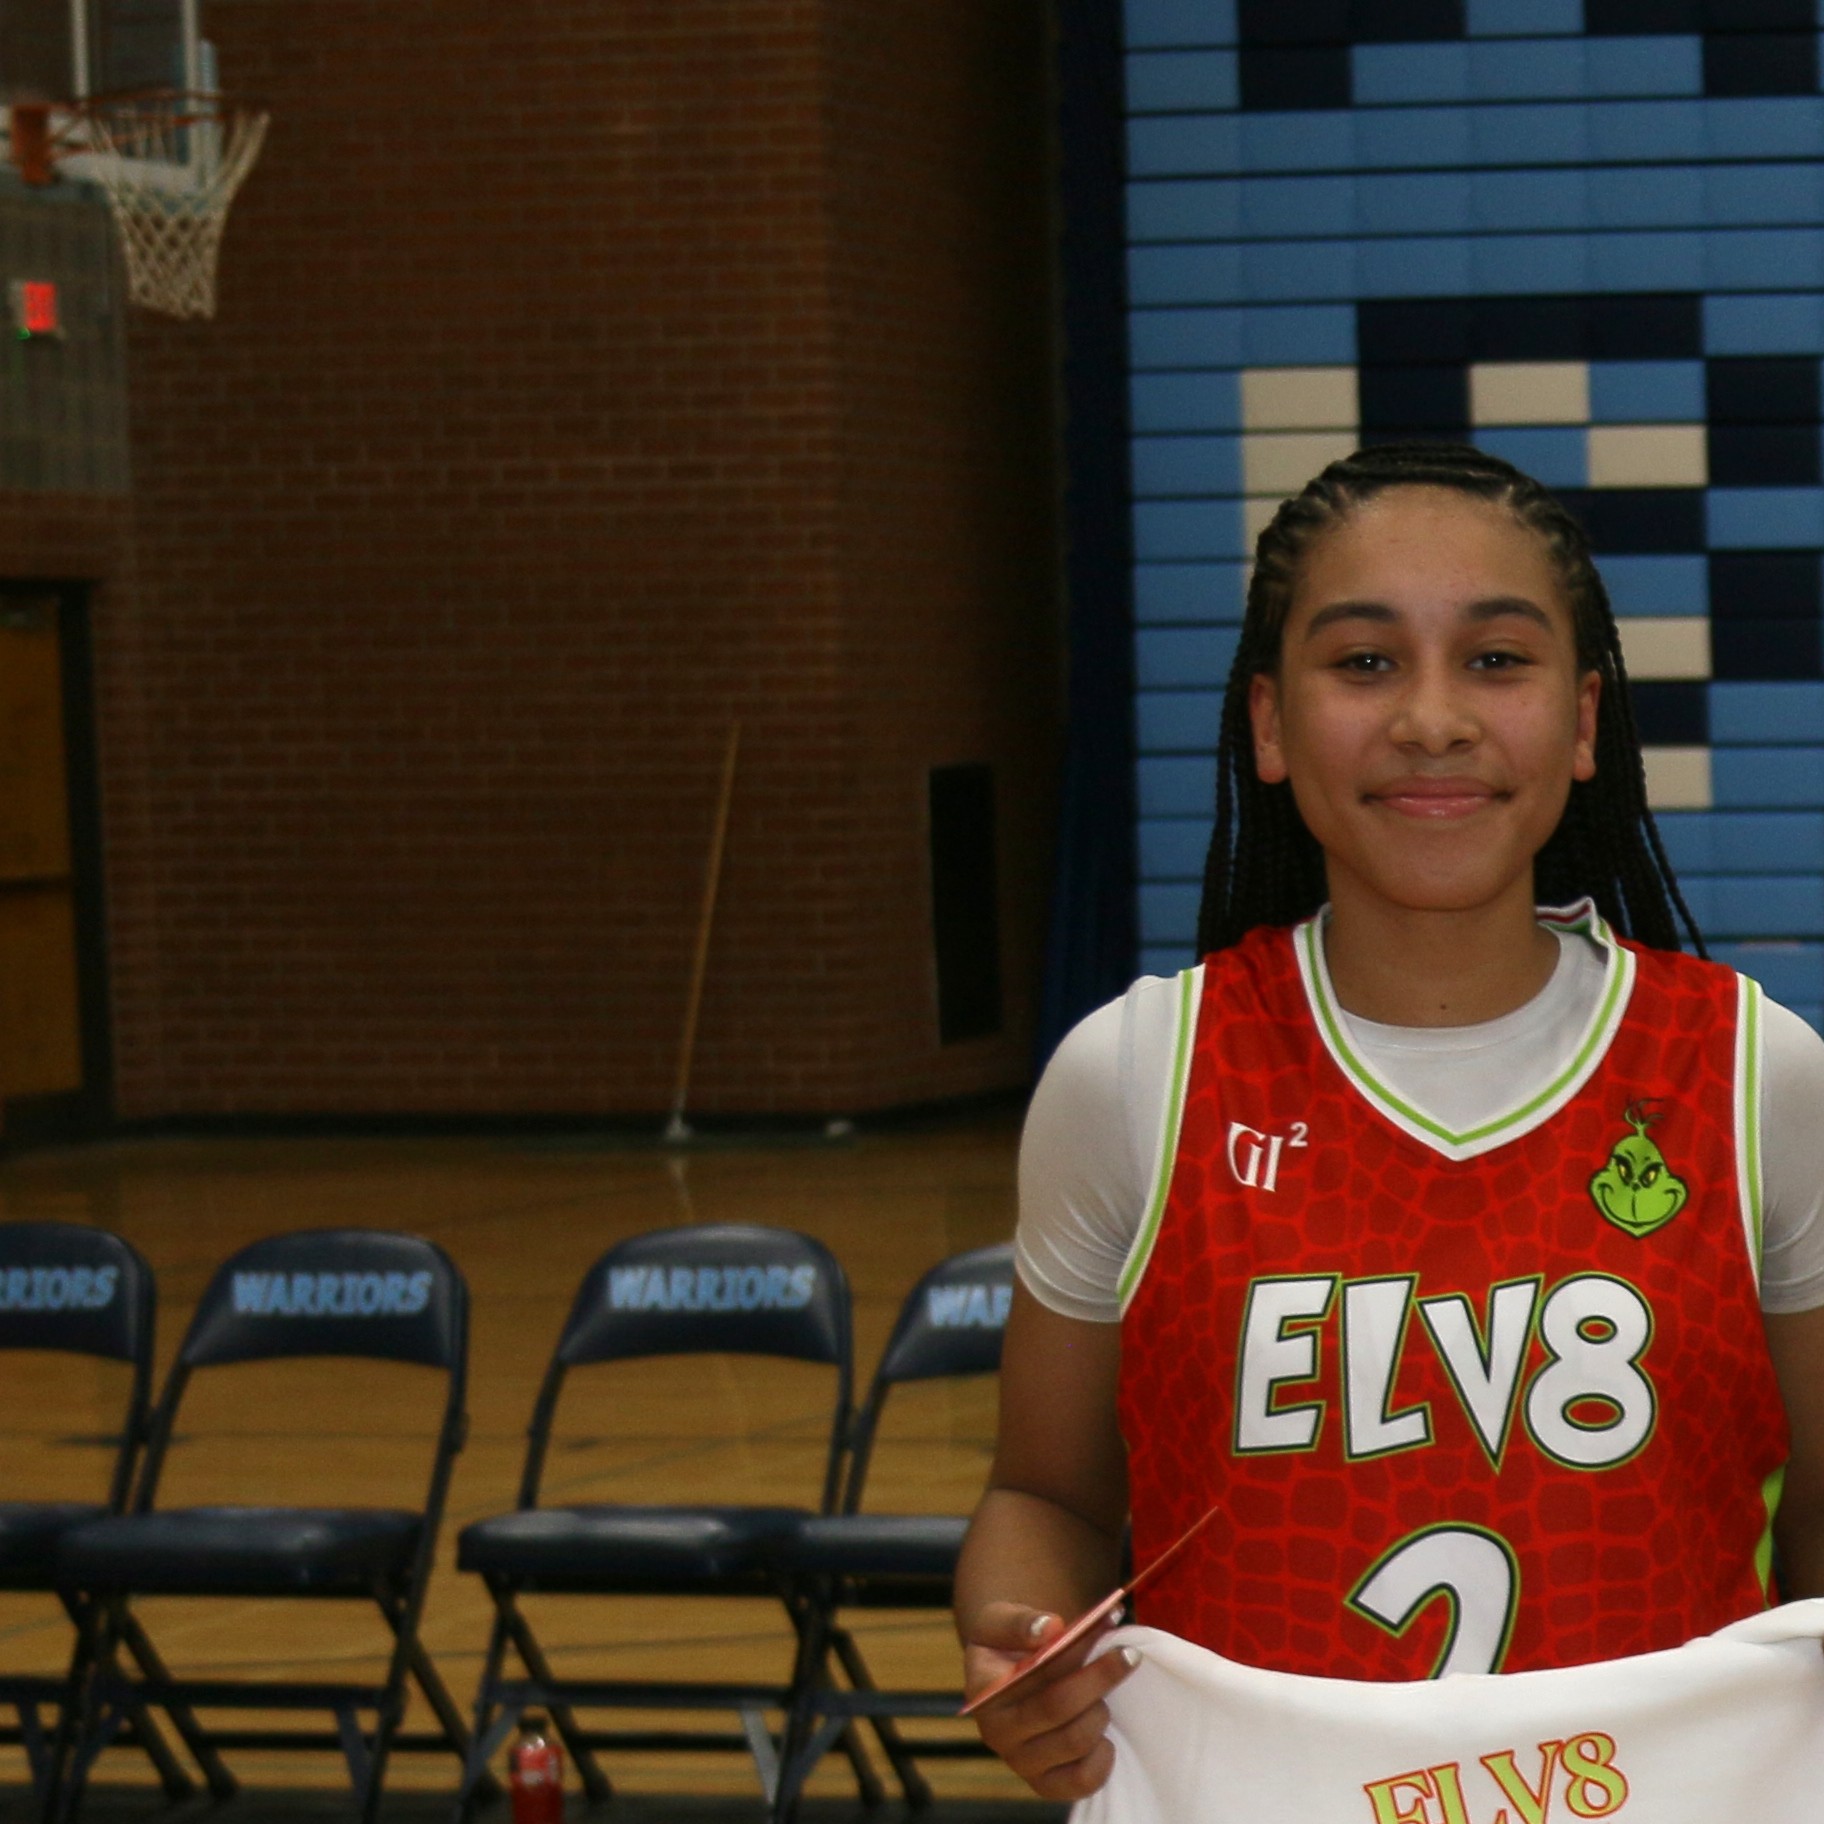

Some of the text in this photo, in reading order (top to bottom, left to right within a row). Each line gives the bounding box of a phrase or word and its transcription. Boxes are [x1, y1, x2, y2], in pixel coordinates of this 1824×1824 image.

[233, 1270, 431, 1315] WARRIORS
[608, 1265, 816, 1311] WARRIORS
[1232, 1271, 1657, 1476] ELV8
[1344, 1522, 1520, 1680] 2
